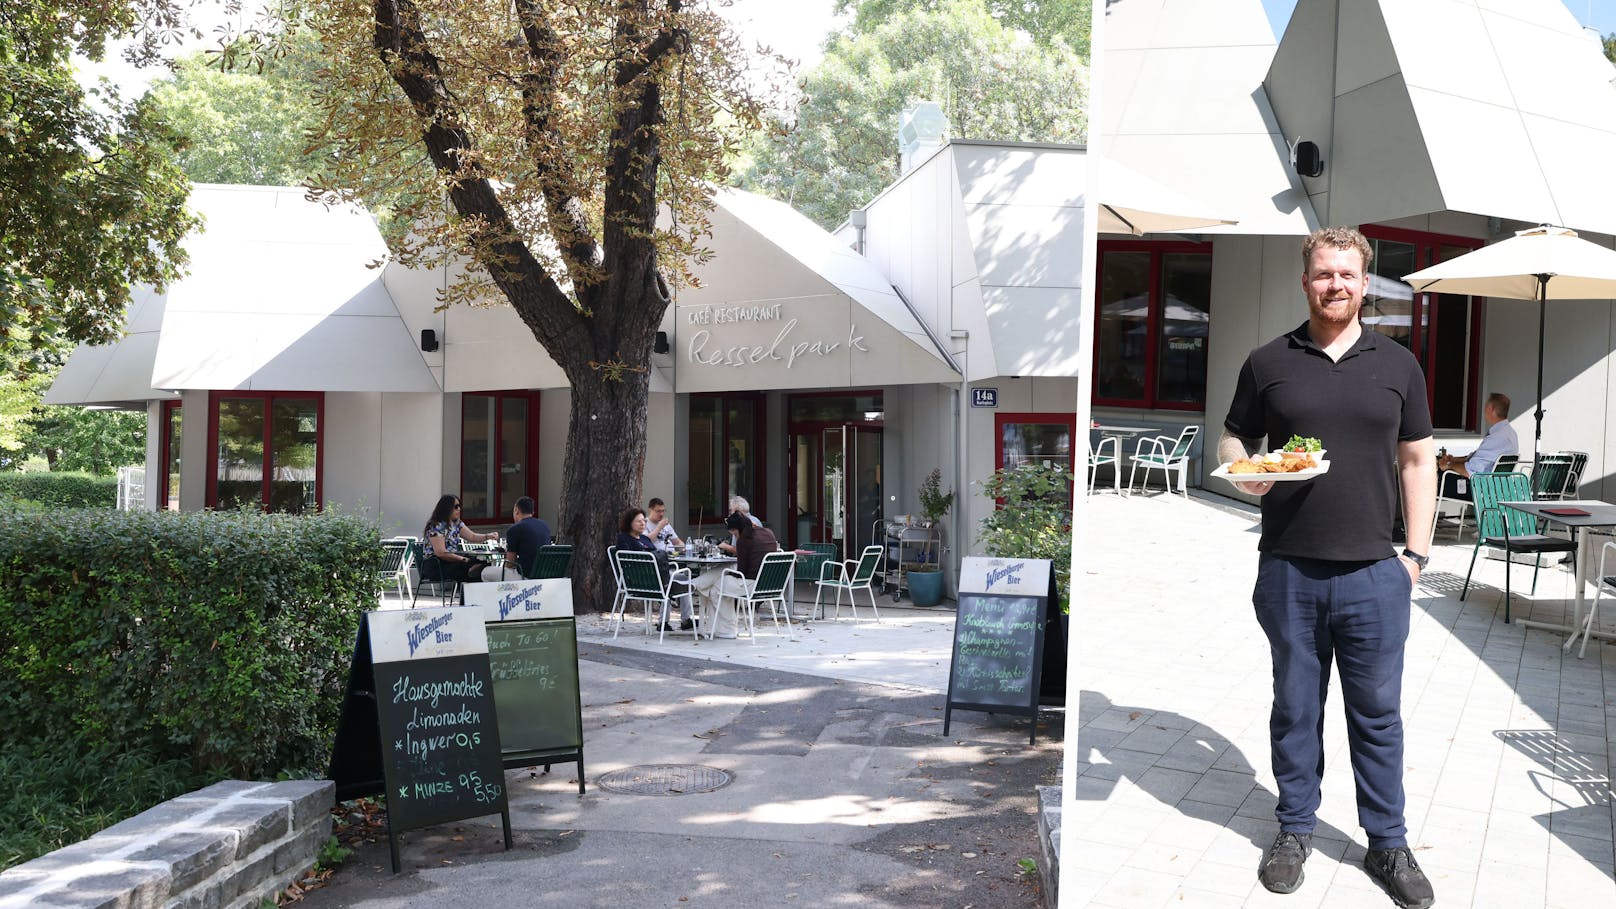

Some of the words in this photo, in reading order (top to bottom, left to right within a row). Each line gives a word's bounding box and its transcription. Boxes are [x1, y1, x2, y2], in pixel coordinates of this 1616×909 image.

[688, 306, 712, 325] CAFÉ
[714, 304, 782, 324] RESTAURANT
[976, 390, 993, 400] 14a
[985, 562, 1024, 591] Wieselburger
[1007, 575, 1021, 585] Bier
[498, 584, 543, 621] Wieselburger
[525, 600, 541, 611] Bier
[407, 611, 453, 658] Wieselburger
[435, 630, 453, 644] Bier
[393, 672, 484, 708] Hausgemachte
[406, 703, 480, 730] Limonaden
[406, 732, 455, 759] Ingwer
[455, 732, 481, 749] 0,5
[415, 781, 454, 799] MINZE
